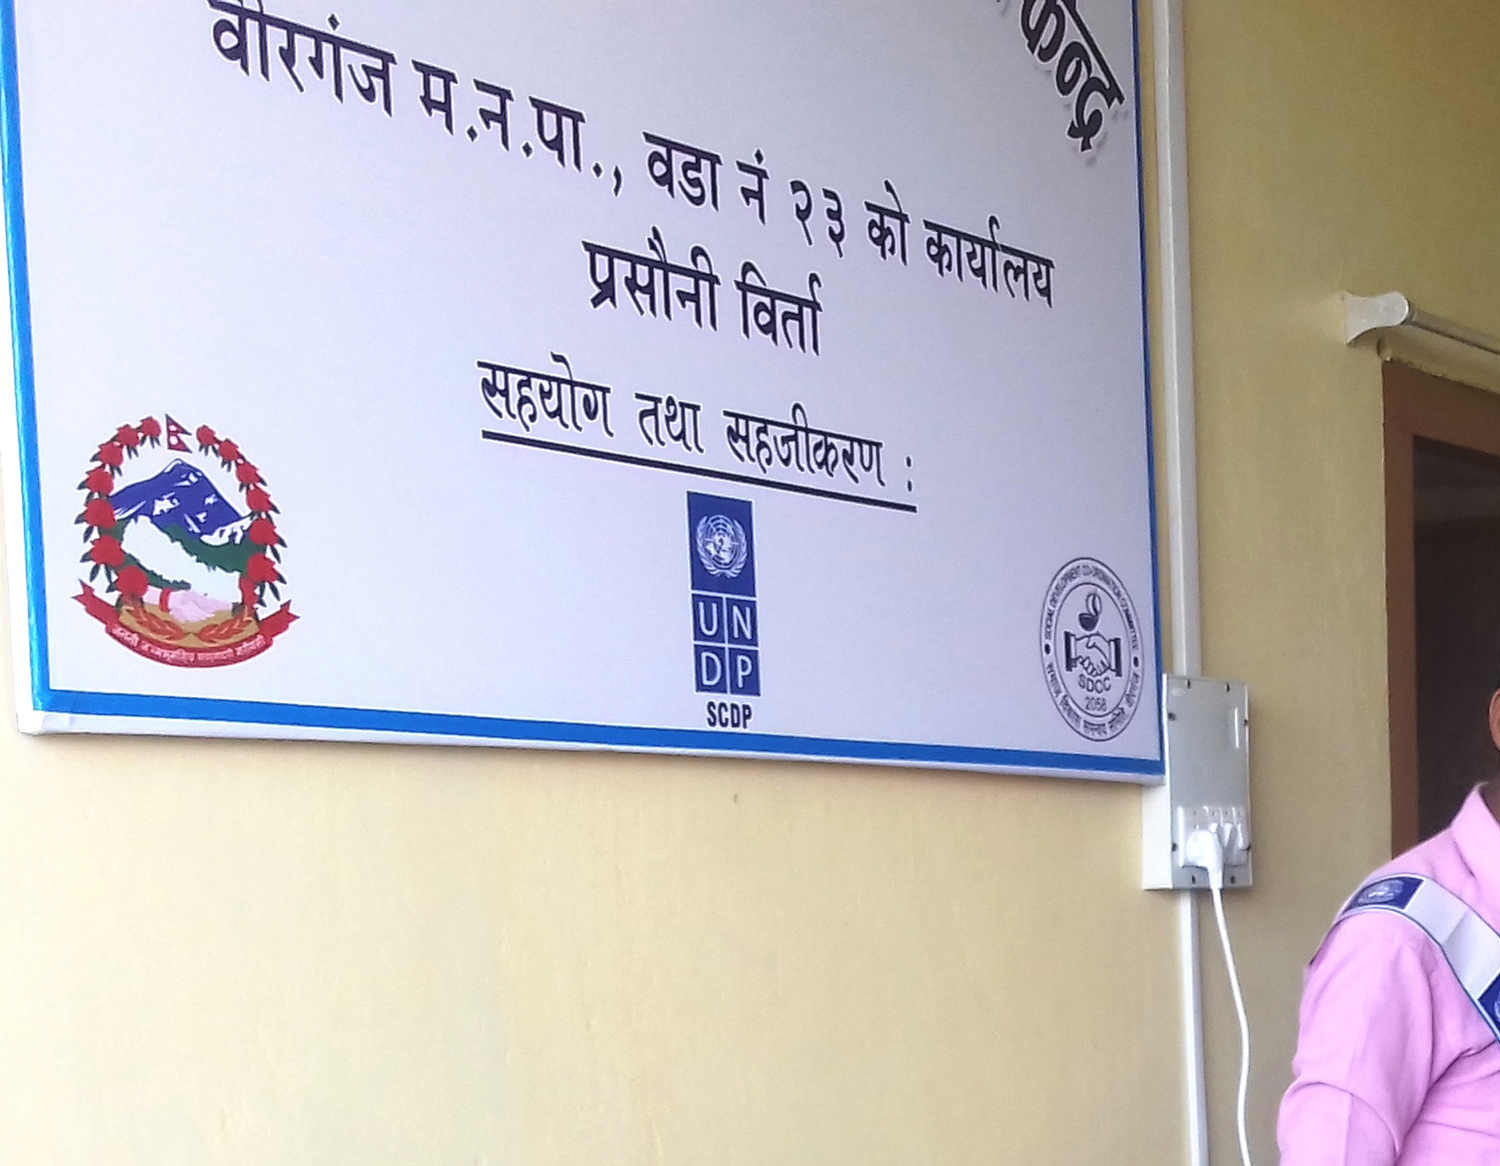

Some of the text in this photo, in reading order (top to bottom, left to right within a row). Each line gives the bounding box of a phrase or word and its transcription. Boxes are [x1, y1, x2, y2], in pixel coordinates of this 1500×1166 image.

[207, 0, 397, 118] वीरगंज
[643, 132, 723, 212] वडा
[736, 149, 769, 225] नं
[790, 180, 846, 259] २३
[864, 180, 910, 266] को
[923, 216, 1055, 308] कार्यालय
[582, 226, 823, 356] प्रसौनी विर्ता
[477, 352, 614, 437] सहयोग
[634, 393, 704, 453] तथा
[723, 402, 886, 487] सहजीकरण
[706, 700, 753, 729] SCDP
[1078, 674, 1112, 694] SDCC
